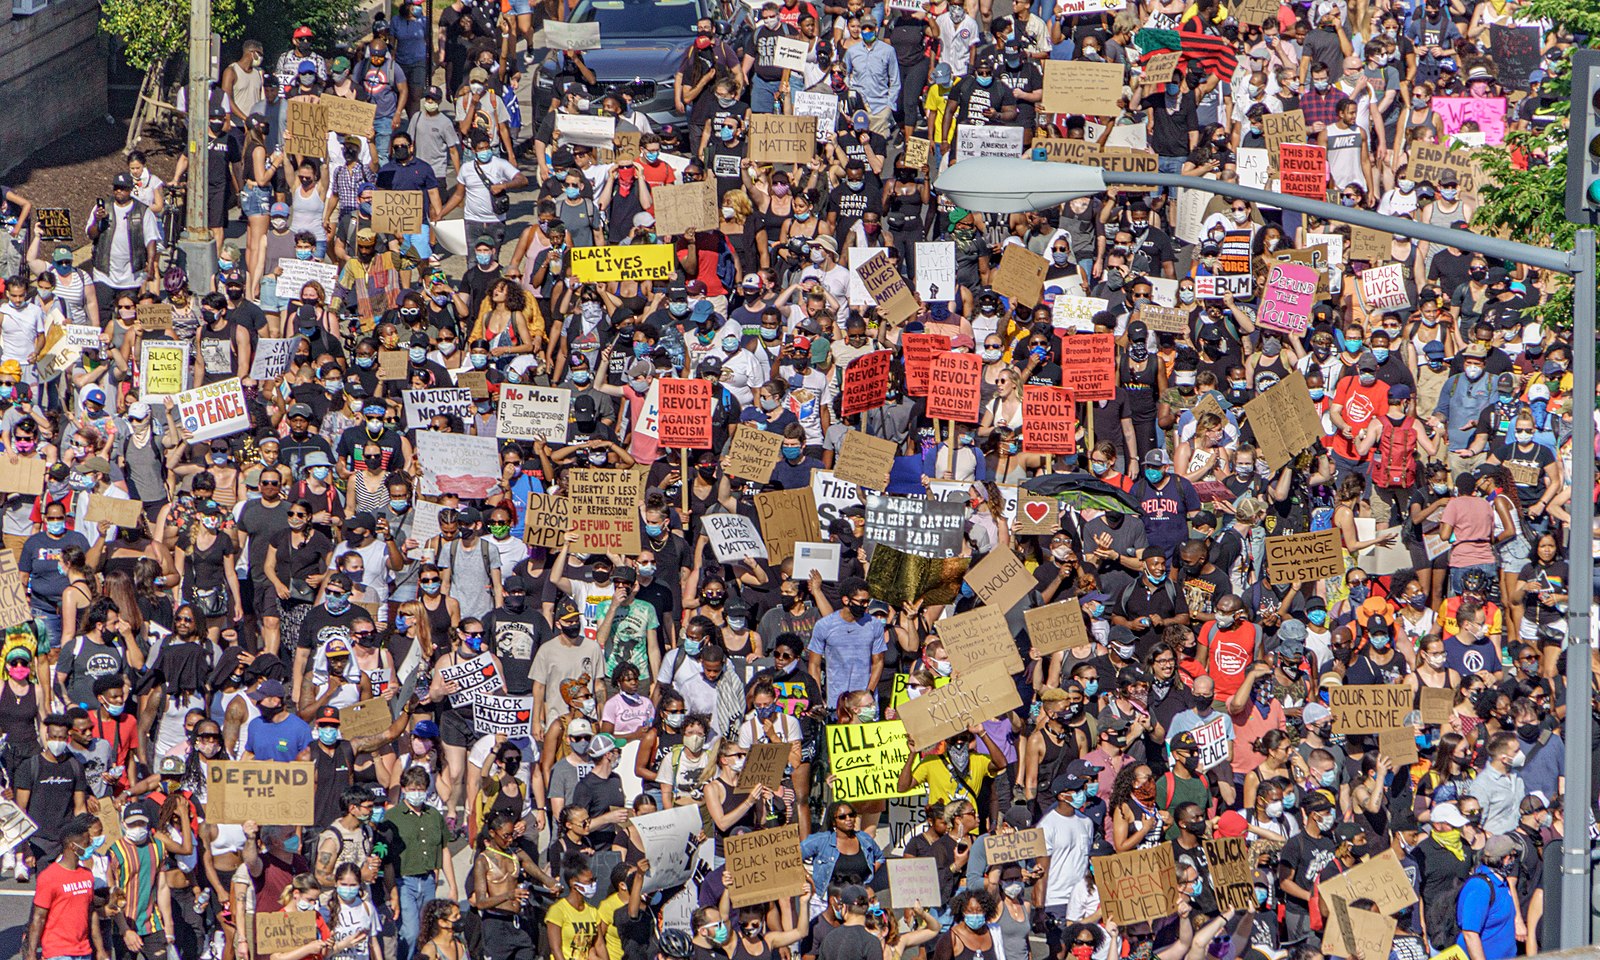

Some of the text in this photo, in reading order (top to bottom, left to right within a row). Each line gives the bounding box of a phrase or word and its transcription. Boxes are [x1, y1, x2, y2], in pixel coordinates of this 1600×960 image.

[1063, 0, 1085, 12] PAIN
[1149, 63, 1173, 72] LIVES
[292, 104, 327, 123] BLACK
[292, 123, 327, 138] LIVES
[750, 121, 816, 134] BLACK LIVES
[1267, 117, 1302, 136] BLACK
[960, 130, 1007, 139] WE WILL
[759, 139, 807, 152] MATTER
[961, 141, 1009, 149] RID AMERICA
[1333, 136, 1356, 148] NIKE
[1283, 149, 1302, 158] THIS
[1305, 150, 1314, 158] IS
[1088, 157, 1157, 172] DEFUND
[1283, 160, 1323, 171] REVOLT
[1283, 174, 1323, 183] AGAINST
[1285, 182, 1320, 192] RACISM
[38, 210, 64, 220] BLACK
[376, 205, 422, 217] SHOOT
[45, 218, 68, 227] LIVES
[388, 217, 414, 232] ME
[573, 247, 611, 262] BLACK
[918, 244, 950, 256] BLACK
[596, 257, 642, 272] LIVES
[859, 256, 889, 281] BLACK
[920, 256, 950, 267] LIVES
[621, 261, 671, 279] MATTER!
[916, 268, 953, 282] MATTER
[1364, 267, 1399, 283] BLACK
[867, 267, 894, 292] LIVES
[1216, 278, 1249, 295] BLM
[1269, 268, 1315, 294] DEFUND
[875, 280, 906, 306] MATTER
[1365, 280, 1398, 296] LIVES
[1276, 291, 1298, 306] THE
[1367, 293, 1408, 309] MATTER
[1262, 300, 1307, 330] POLICE
[272, 342, 291, 353] SAY
[1068, 337, 1108, 346] George Floyd
[148, 350, 182, 362] BLACK
[872, 355, 887, 366] IS A
[152, 363, 176, 371] LIVES
[934, 356, 979, 371] THIS IS A
[148, 375, 179, 387] MATTER
[848, 366, 884, 382] REVOLT
[932, 370, 977, 385] REVOLT
[1069, 374, 1109, 382] JUSTICE
[179, 380, 239, 404] NO JUSTICE
[662, 384, 708, 395] THIS IS A
[847, 380, 884, 395] AGAINST
[931, 386, 976, 398] AGAINST
[409, 390, 470, 403] NO JUSTICE
[662, 396, 707, 410] REVOLT
[848, 391, 881, 404] RACISM
[934, 397, 973, 410] RACISM
[1027, 392, 1071, 402] THIS IS A
[183, 393, 244, 426] NO PEACE
[1026, 405, 1071, 417] REVOLT
[661, 415, 707, 425] AGAINST
[1025, 422, 1070, 431] AGAINST
[664, 426, 705, 436] RACISM
[740, 429, 779, 446] TIRED OF
[1029, 433, 1069, 443] RACISM
[593, 473, 631, 483] COST OF
[572, 484, 637, 495] LIBERTY IS LESS
[822, 480, 856, 500] This
[572, 495, 634, 506] THAN THE PRICE
[888, 498, 924, 513] MAKE
[573, 506, 583, 516] OF
[537, 513, 568, 528] FROM
[572, 520, 633, 533] DEFUND THE
[711, 518, 748, 530] BLACK
[584, 534, 622, 548] POLICE
[721, 529, 749, 540] LIVES
[719, 540, 760, 555] MATTER
[1270, 540, 1333, 559] CHANGE
[1275, 564, 1338, 582] JUSTICE
[979, 559, 1022, 602] ENOUGH
[1031, 613, 1080, 633] NO JUSTICE
[1035, 632, 1052, 645] NO
[441, 659, 484, 680] BLACK
[928, 679, 965, 706] STOP
[1332, 689, 1366, 707] COLOR
[1373, 690, 1384, 706] IS
[1387, 689, 1411, 709] NOT
[475, 694, 523, 710] BLACK
[927, 684, 992, 726] KILLING
[475, 709, 516, 722] LIVES
[1341, 710, 1401, 729] A CRIME
[476, 724, 528, 736] MATTER
[757, 748, 778, 760] NOT
[750, 762, 776, 773] ONE
[211, 768, 308, 785] DEFUND
[244, 787, 276, 797] THE
[987, 831, 1037, 849] DEFUND
[733, 845, 799, 871] BLACK RACIST
[993, 848, 1034, 862] POLICE
[1206, 844, 1245, 866] BLACK
[734, 857, 802, 889] LIVES POLICE
[1102, 851, 1173, 881] HOW MANY
[63, 880, 92, 891] MILANO
[1214, 883, 1260, 910] MATTER
[1105, 887, 1176, 921] FILMED?
